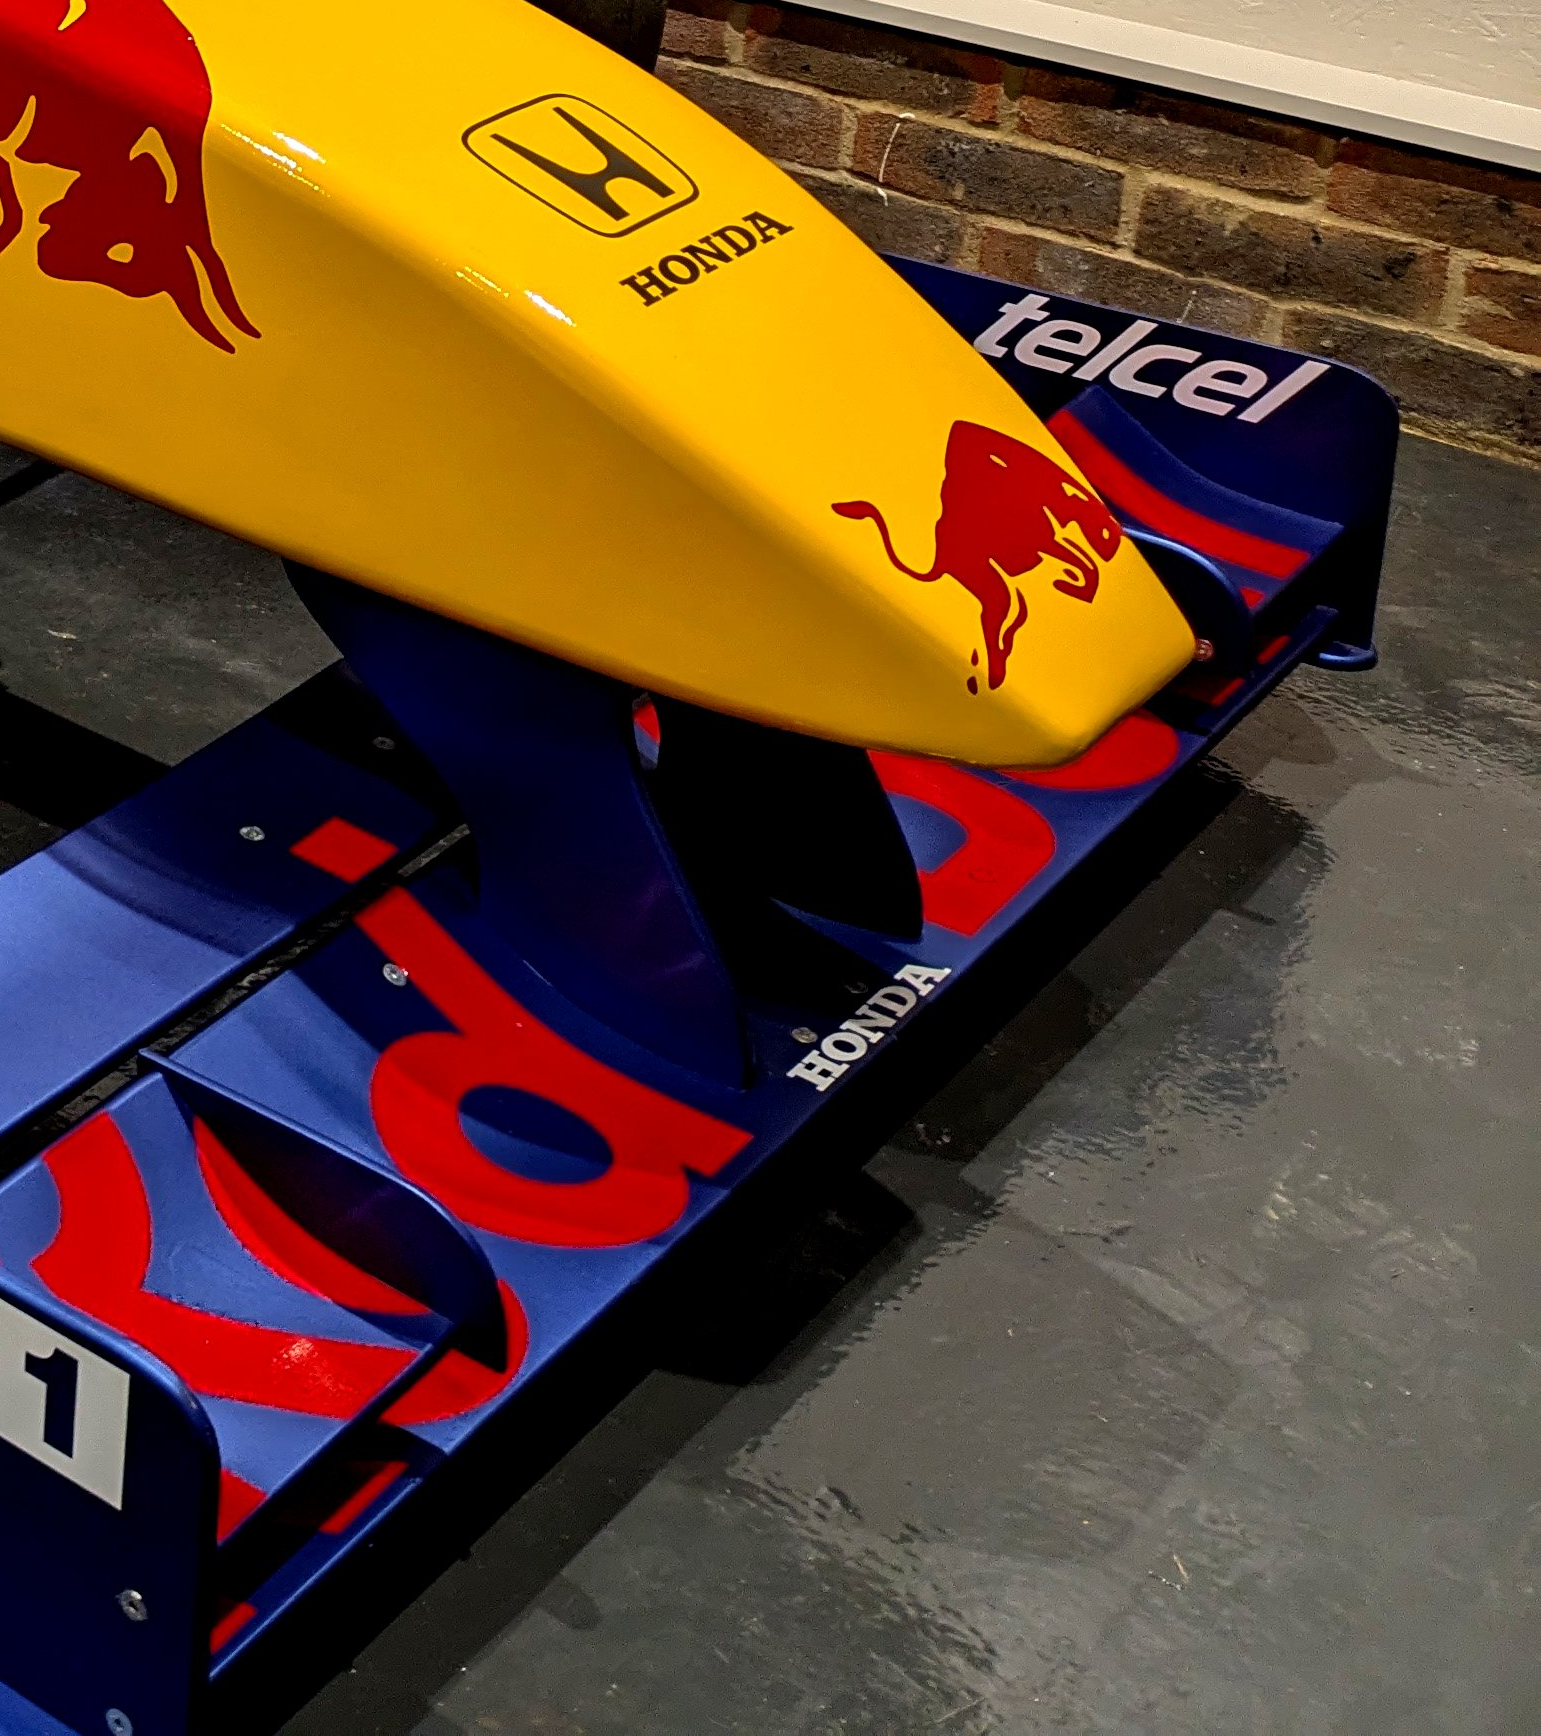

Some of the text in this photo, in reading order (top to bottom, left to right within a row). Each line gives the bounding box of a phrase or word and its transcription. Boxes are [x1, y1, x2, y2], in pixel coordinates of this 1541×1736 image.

[618, 210, 795, 307] HONDA
[973, 293, 1331, 424] telcel
[786, 963, 951, 1092] HONDA
